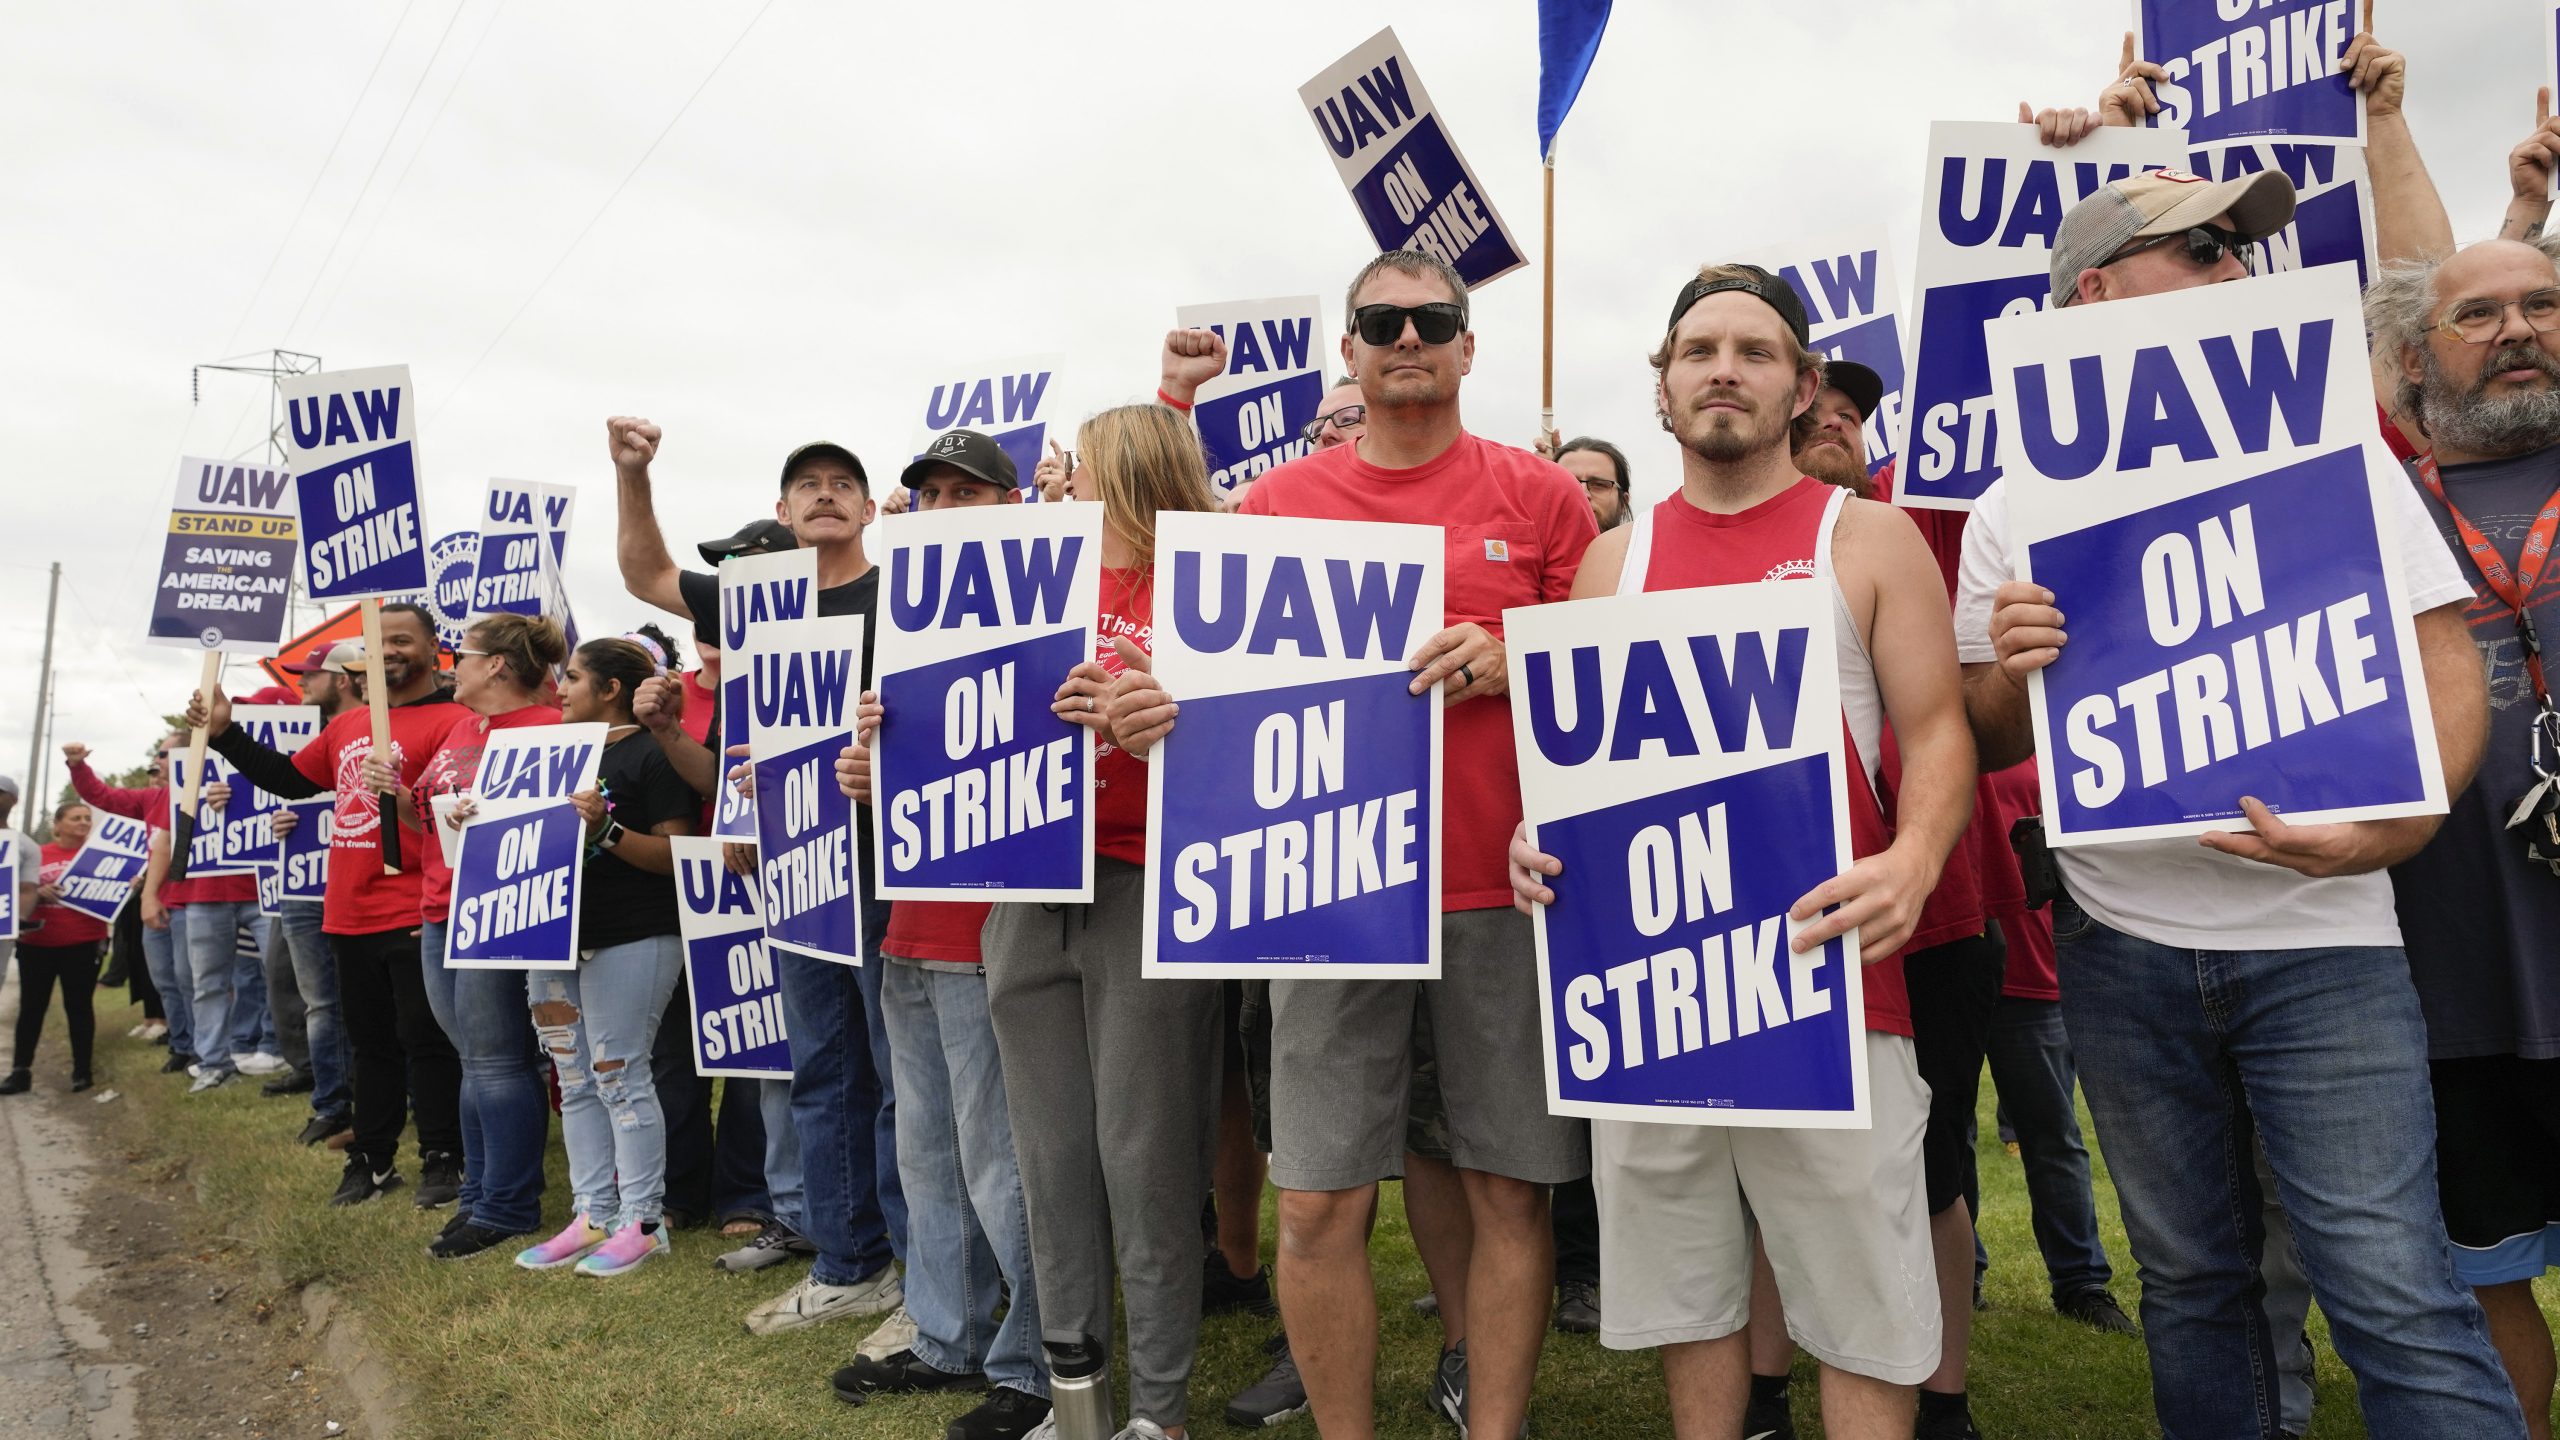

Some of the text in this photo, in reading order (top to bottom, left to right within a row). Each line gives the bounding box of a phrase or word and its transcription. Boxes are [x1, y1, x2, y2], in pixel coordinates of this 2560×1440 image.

[2156, 1, 2348, 131] STRIKE
[1313, 55, 1416, 159] UAW
[1383, 152, 1433, 225] ON
[1774, 249, 1878, 327] AW
[289, 386, 400, 450] UAW
[926, 371, 1052, 431] UAW
[1238, 391, 1286, 451] ON
[2013, 318, 2334, 481] UAW
[935, 437, 967, 450] FOX
[198, 464, 290, 509] UAW
[334, 461, 377, 523] ON
[177, 516, 293, 536] STAND UP
[185, 547, 272, 567] SAVING
[310, 502, 418, 590] STRIKE
[504, 537, 538, 571] ON
[162, 572, 286, 594] AMERICAN
[177, 593, 263, 613] DREAM
[216, 566, 234, 574] THE
[477, 570, 540, 608] STRIK
[890, 536, 1084, 632] UAW
[2141, 503, 2266, 648] ON
[2486, 562, 2510, 586] Tigers
[1100, 613, 1136, 635] The
[1173, 550, 1425, 662] UAW
[754, 649, 852, 728] UAW
[944, 661, 1015, 761] ON
[1524, 627, 1810, 767] UAW
[2065, 592, 2389, 810] STRIKE
[481, 743, 593, 800] UAW
[1253, 699, 1346, 810] ON
[785, 758, 819, 838] ON
[890, 735, 1074, 872] STRIKE
[93, 856, 128, 879] ON
[496, 818, 544, 882] ON
[766, 825, 849, 928] STRIKE
[1172, 788, 1418, 944] STRIKE
[1627, 801, 1734, 938] ON
[60, 875, 132, 903] STRIKE
[456, 865, 569, 951] STRIKE
[681, 858, 761, 916] UA
[728, 937, 775, 996] ON
[1564, 911, 1832, 1082] STRIKE
[702, 992, 787, 1061] STRI
